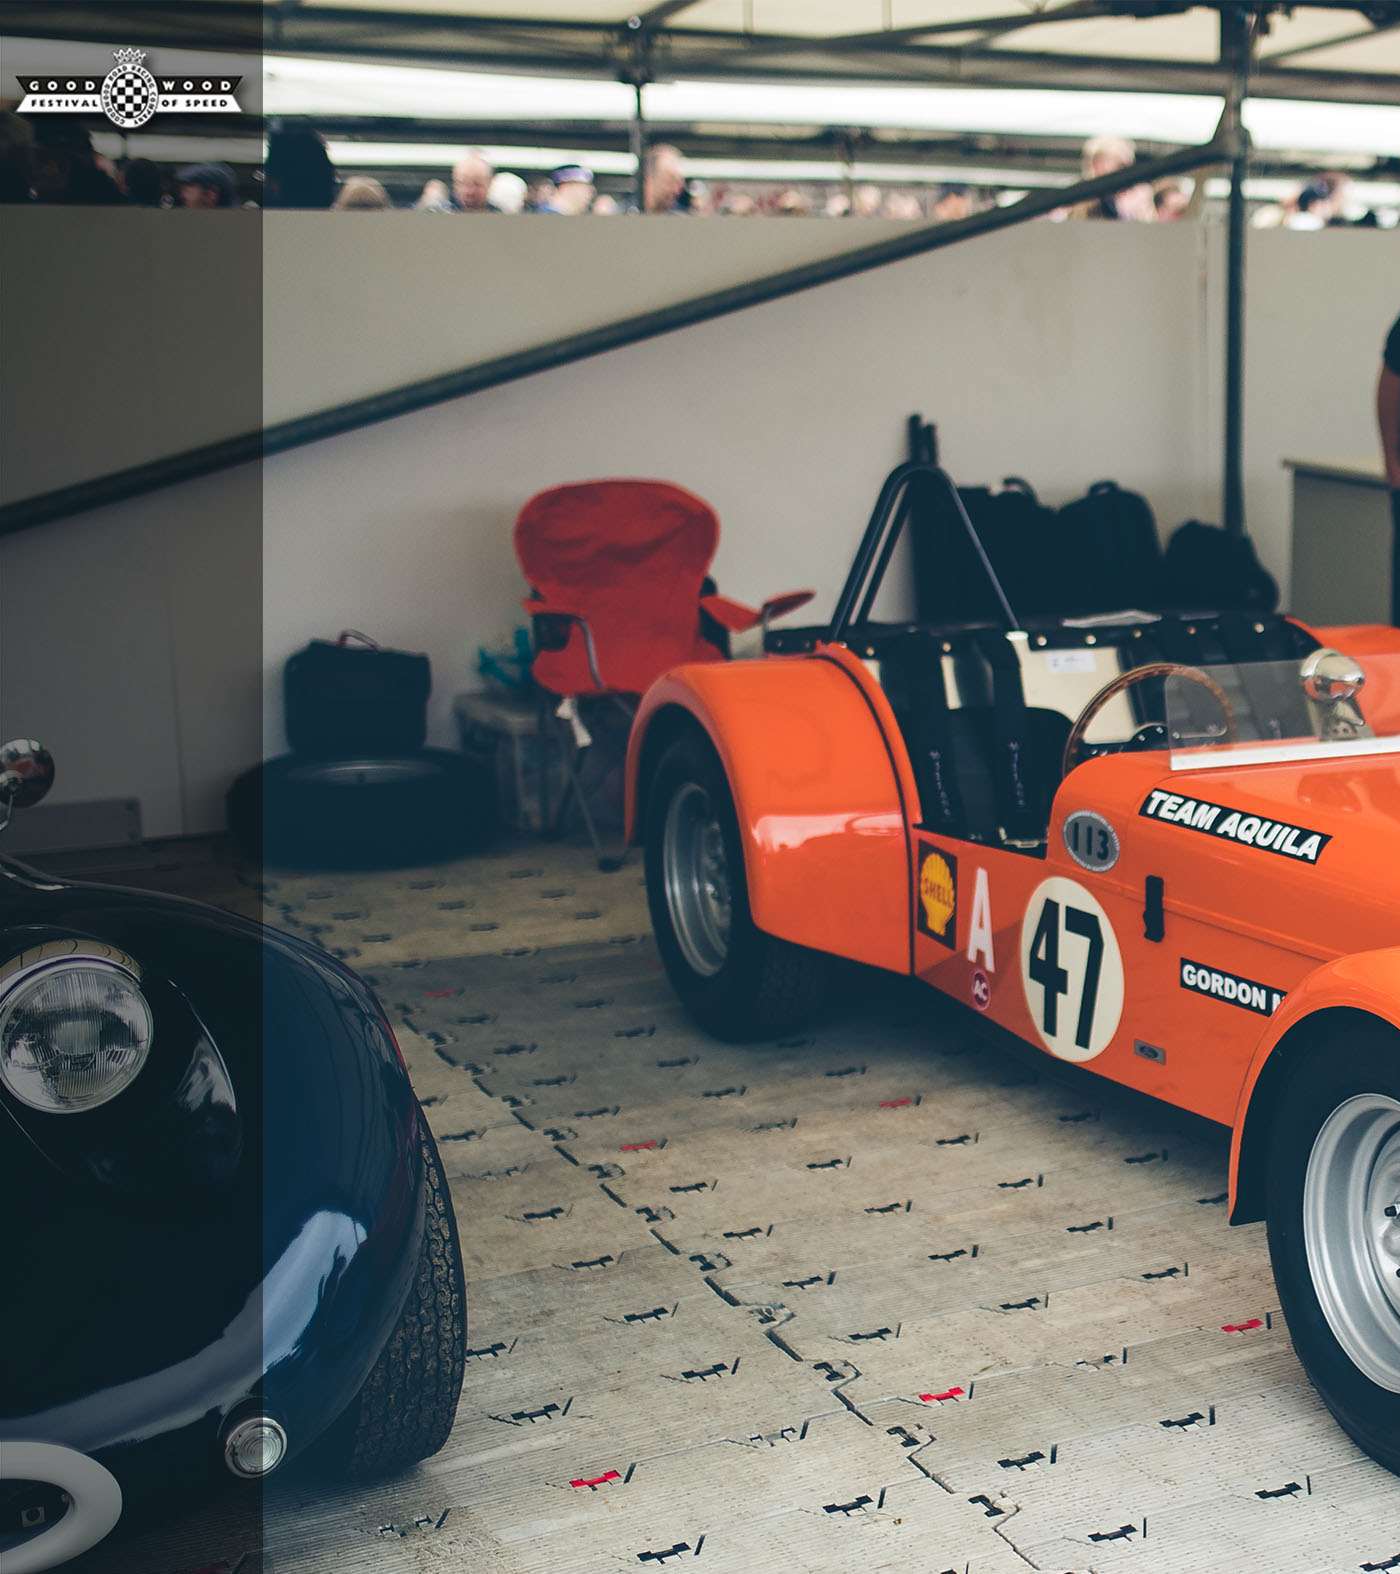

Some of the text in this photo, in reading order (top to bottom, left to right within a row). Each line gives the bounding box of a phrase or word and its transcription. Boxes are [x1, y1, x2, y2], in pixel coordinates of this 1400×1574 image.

[1072, 822, 1109, 861] 113
[1146, 790, 1322, 861] TEAM AQUILA
[924, 877, 951, 908] SHELL
[967, 866, 996, 974] A
[1029, 897, 1105, 1050] 47
[1182, 964, 1267, 1010] GORDON
